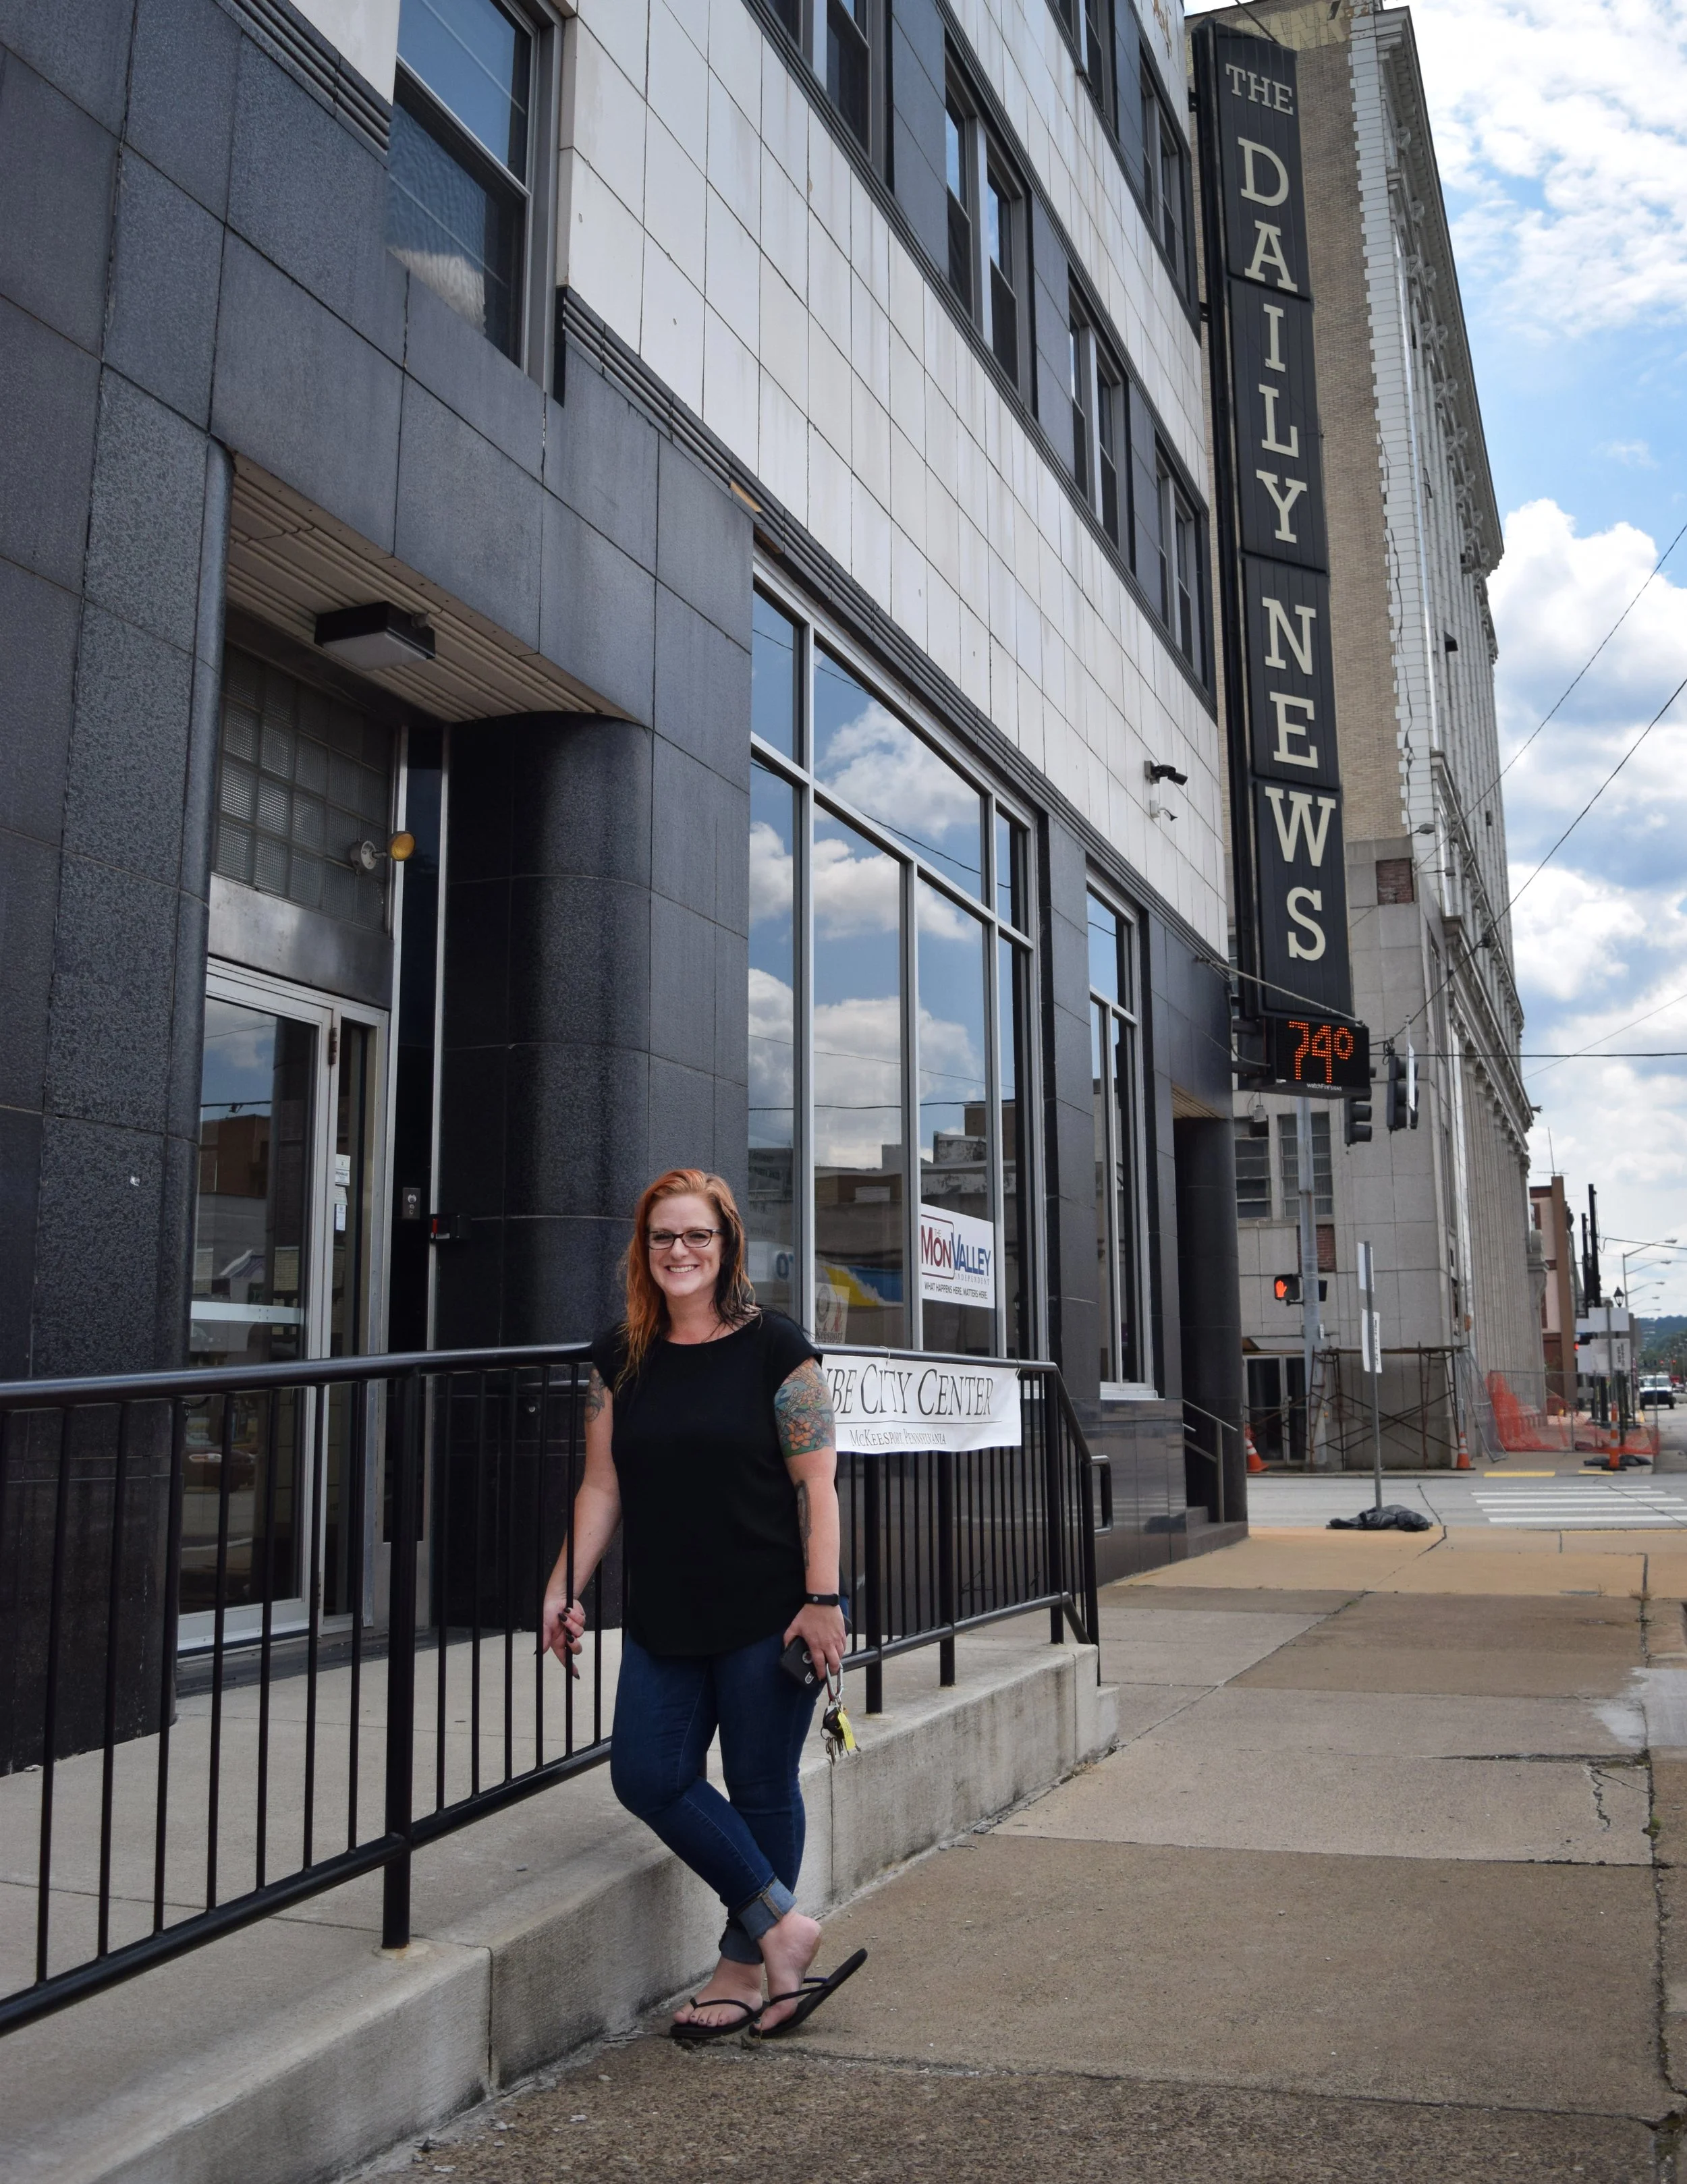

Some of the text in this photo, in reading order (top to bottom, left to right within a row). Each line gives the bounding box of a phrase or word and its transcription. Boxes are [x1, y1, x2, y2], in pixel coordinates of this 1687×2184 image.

[1225, 63, 1294, 116] THE
[1238, 136, 1308, 543] DAILY
[1263, 597, 1336, 962] NEWS
[934, 1229, 942, 1238] THE
[924, 1282, 935, 1291] WHAT
[936, 1283, 953, 1294] HAPPENS
[963, 1288, 978, 1297] MATTERS
[955, 1273, 990, 1286] INDEPENDENT
[860, 1364, 912, 1414] CITY
[918, 1368, 993, 1416] CENTER
[904, 1428, 946, 1445] PENNSYLVANIA
